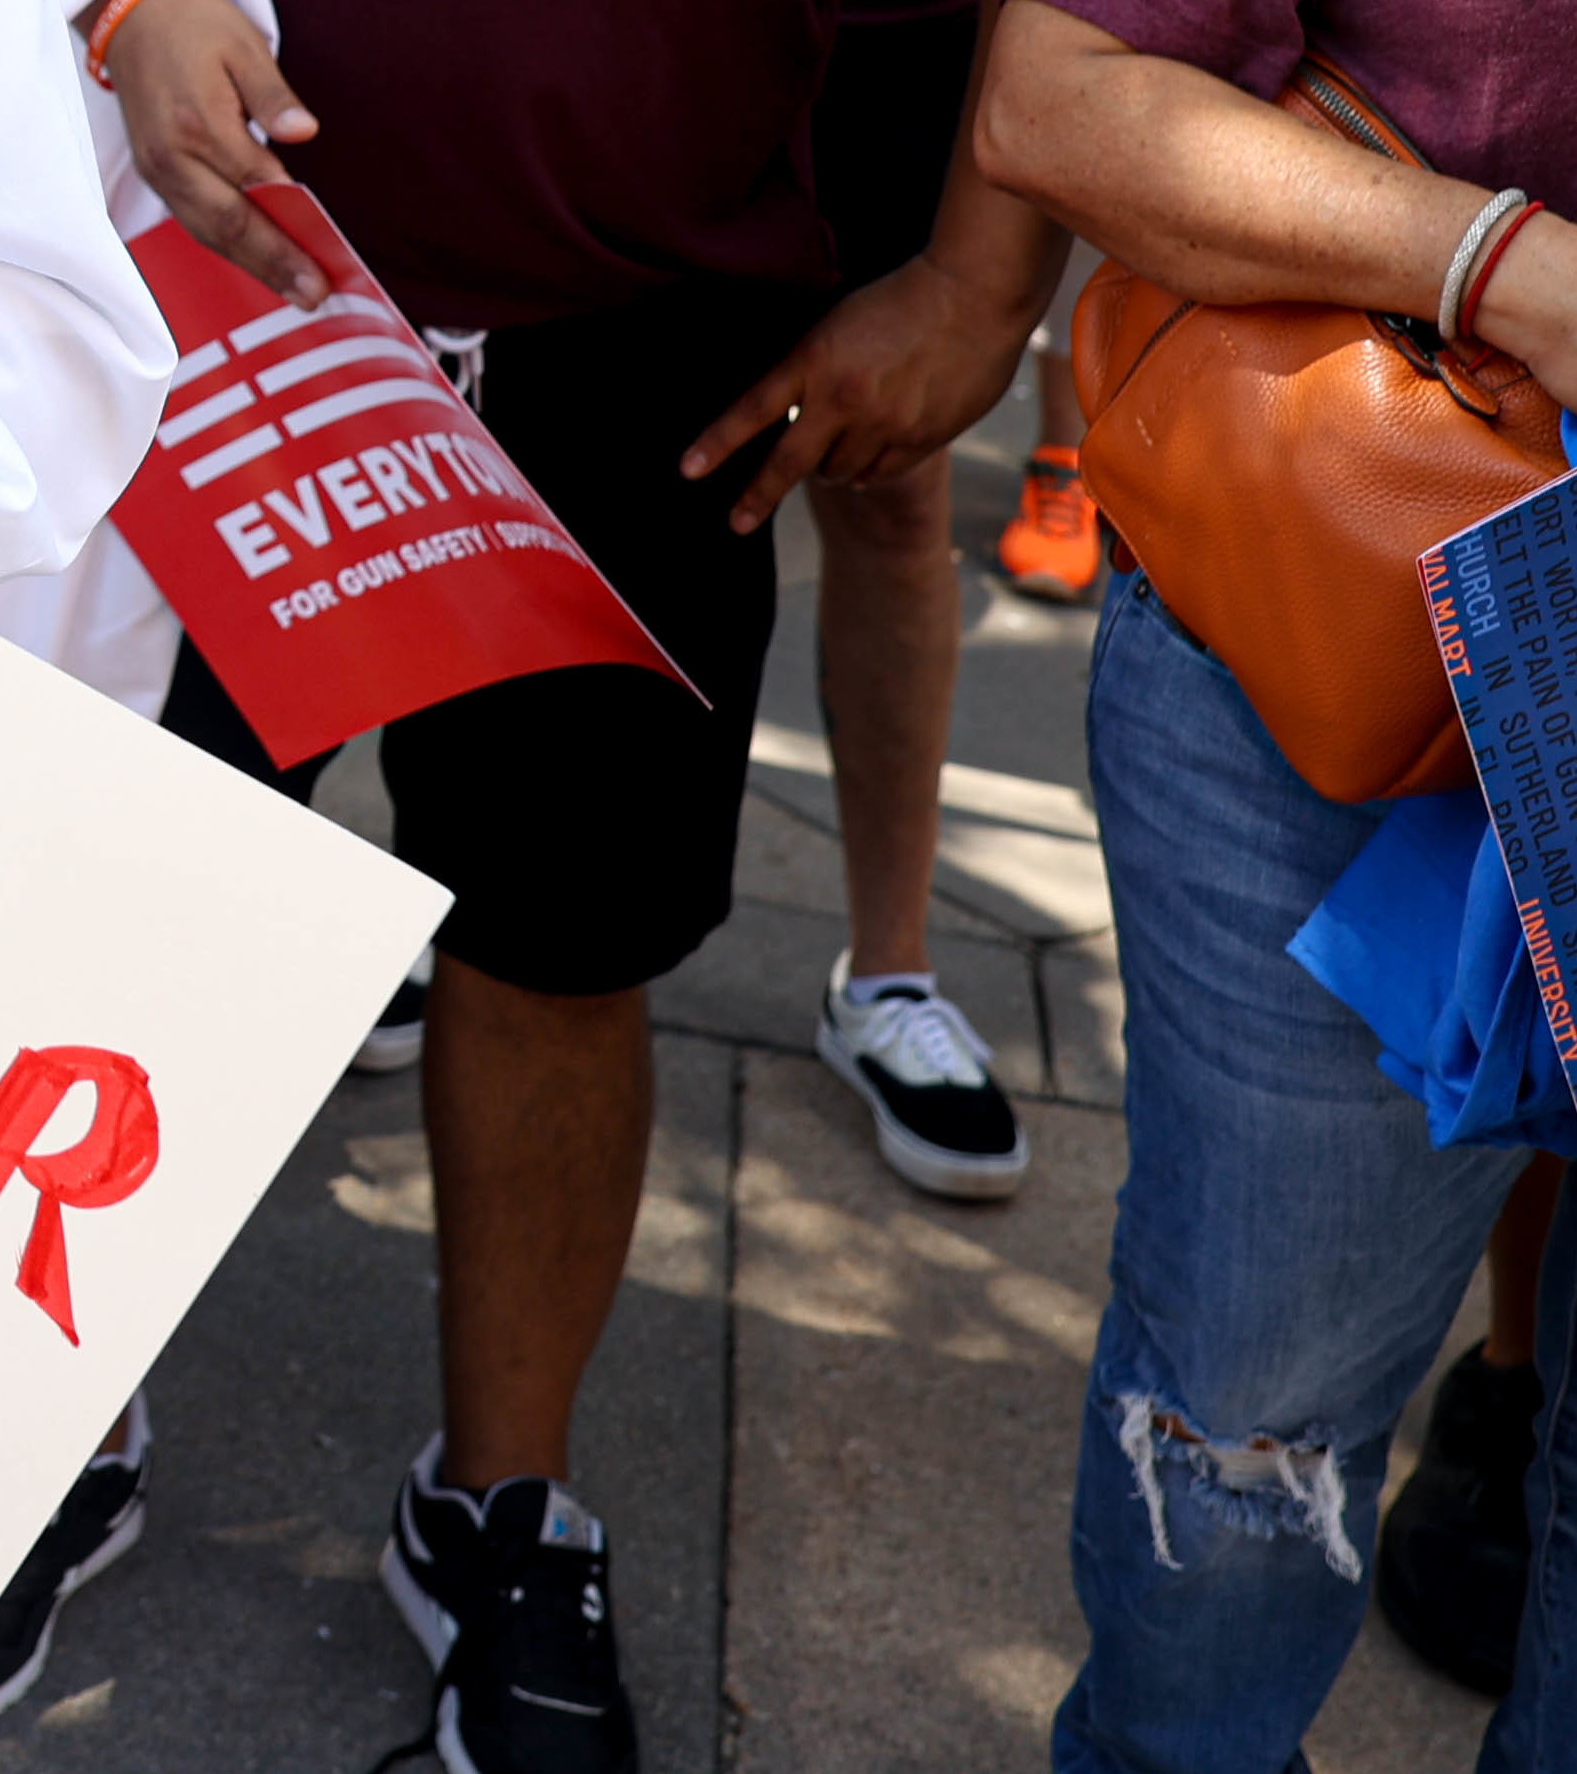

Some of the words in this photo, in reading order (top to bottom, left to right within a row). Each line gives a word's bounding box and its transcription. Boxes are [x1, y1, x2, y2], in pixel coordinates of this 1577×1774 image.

[213, 430, 548, 580] EVERYTO
[1492, 507, 1530, 565] ELT
[269, 583, 339, 628] FOR
[335, 549, 403, 600] GUN
[399, 523, 489, 573] SAFETY
[1504, 568, 1542, 634] THE
[1518, 634, 1564, 711] PAIN
[1452, 528, 1501, 638] HURCH
[1481, 654, 1516, 693] IN
[1499, 711, 1577, 908] SUTHERLAND
[1542, 711, 1577, 747] OF
